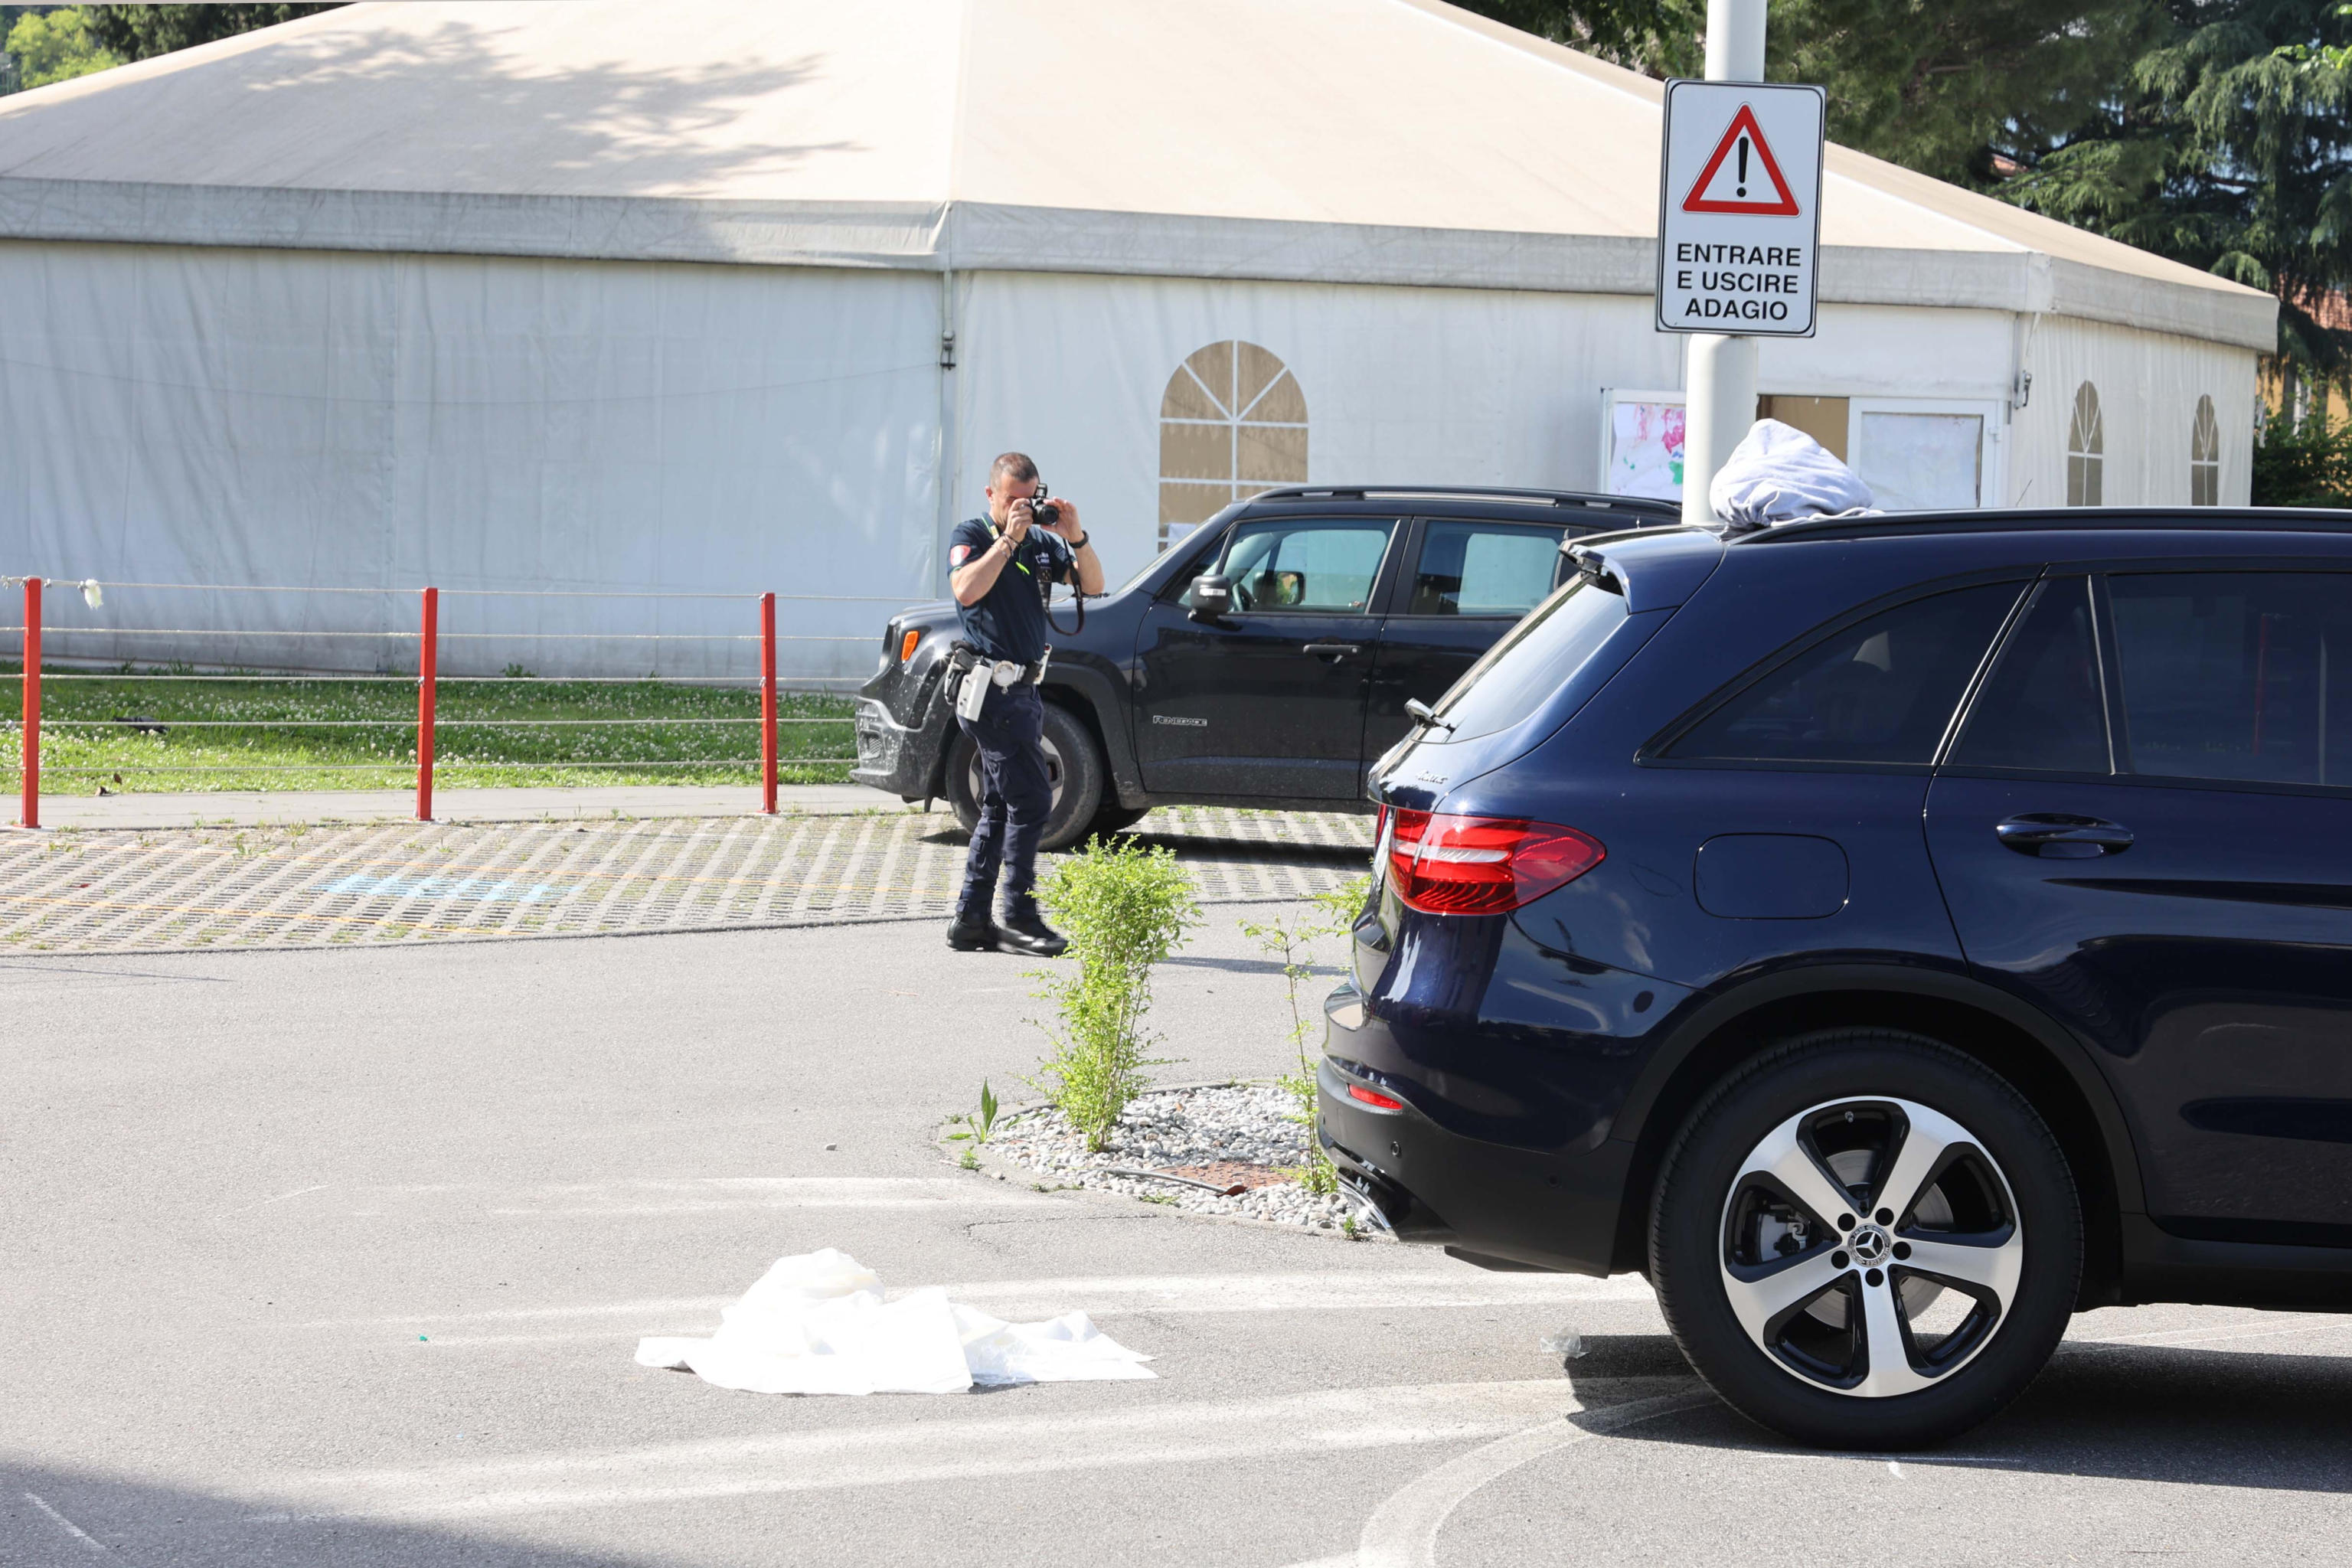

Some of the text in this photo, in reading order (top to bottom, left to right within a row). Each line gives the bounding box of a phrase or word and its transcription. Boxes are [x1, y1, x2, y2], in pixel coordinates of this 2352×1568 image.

[1677, 243, 1802, 267] ENTRARE
[1677, 270, 1798, 294] E USCIRE
[1684, 298, 1788, 321] ADAGIO
